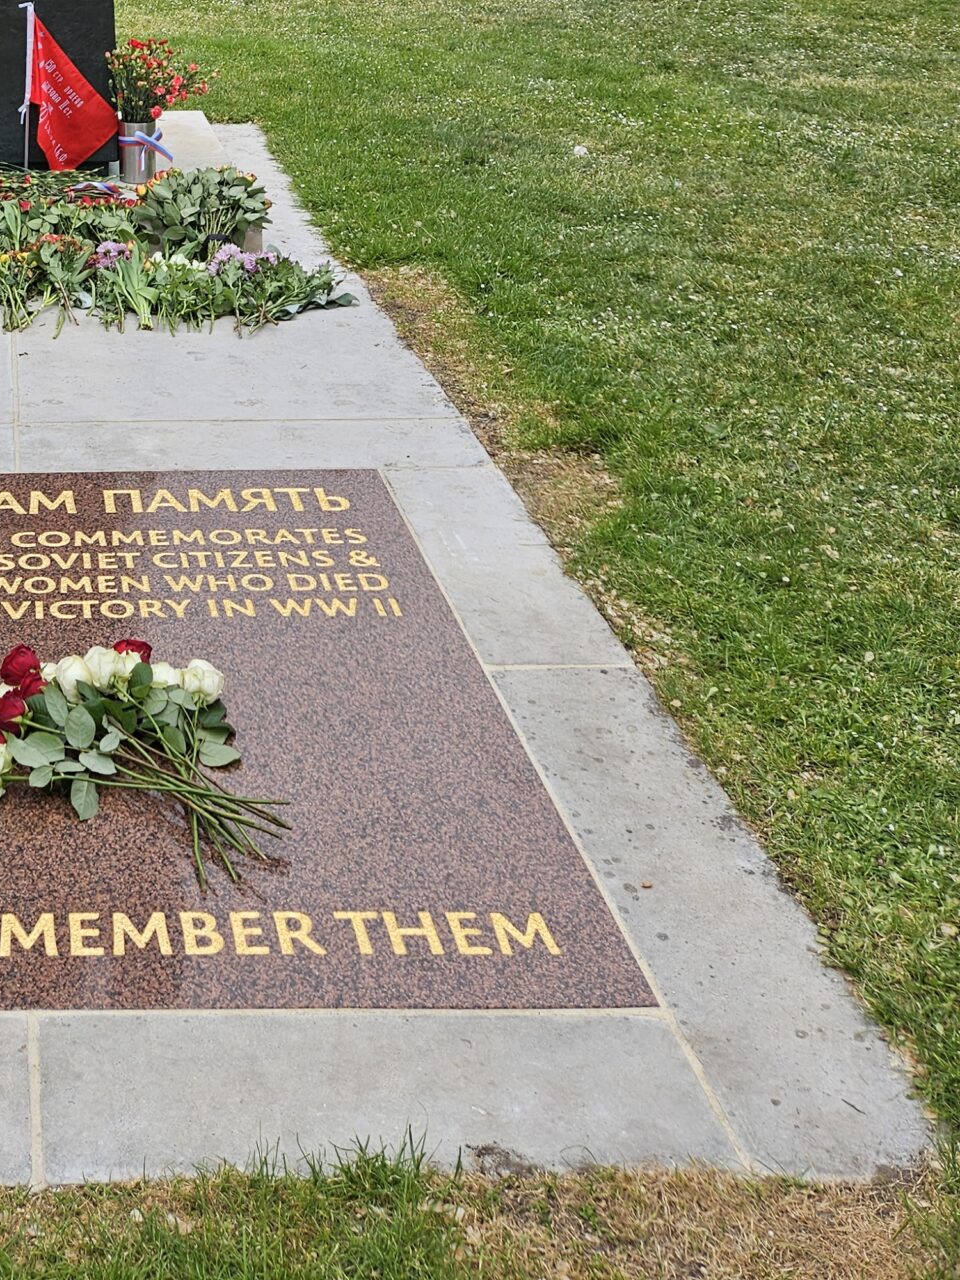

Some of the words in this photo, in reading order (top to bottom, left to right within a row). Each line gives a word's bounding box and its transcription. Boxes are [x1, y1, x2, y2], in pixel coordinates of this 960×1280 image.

[102, 487, 351, 514] ПАМЯТЬ
[10, 528, 368, 549] COMMEMORATES
[152, 550, 336, 569] CITIZENS
[348, 550, 381, 568] &
[163, 573, 275, 592] WHO
[286, 573, 390, 592] DIED
[0, 599, 191, 620] VICTORY
[206, 598, 257, 618] IN
[268, 598, 358, 618] WW
[372, 597, 404, 617] II
[333, 911, 562, 957] THEM
